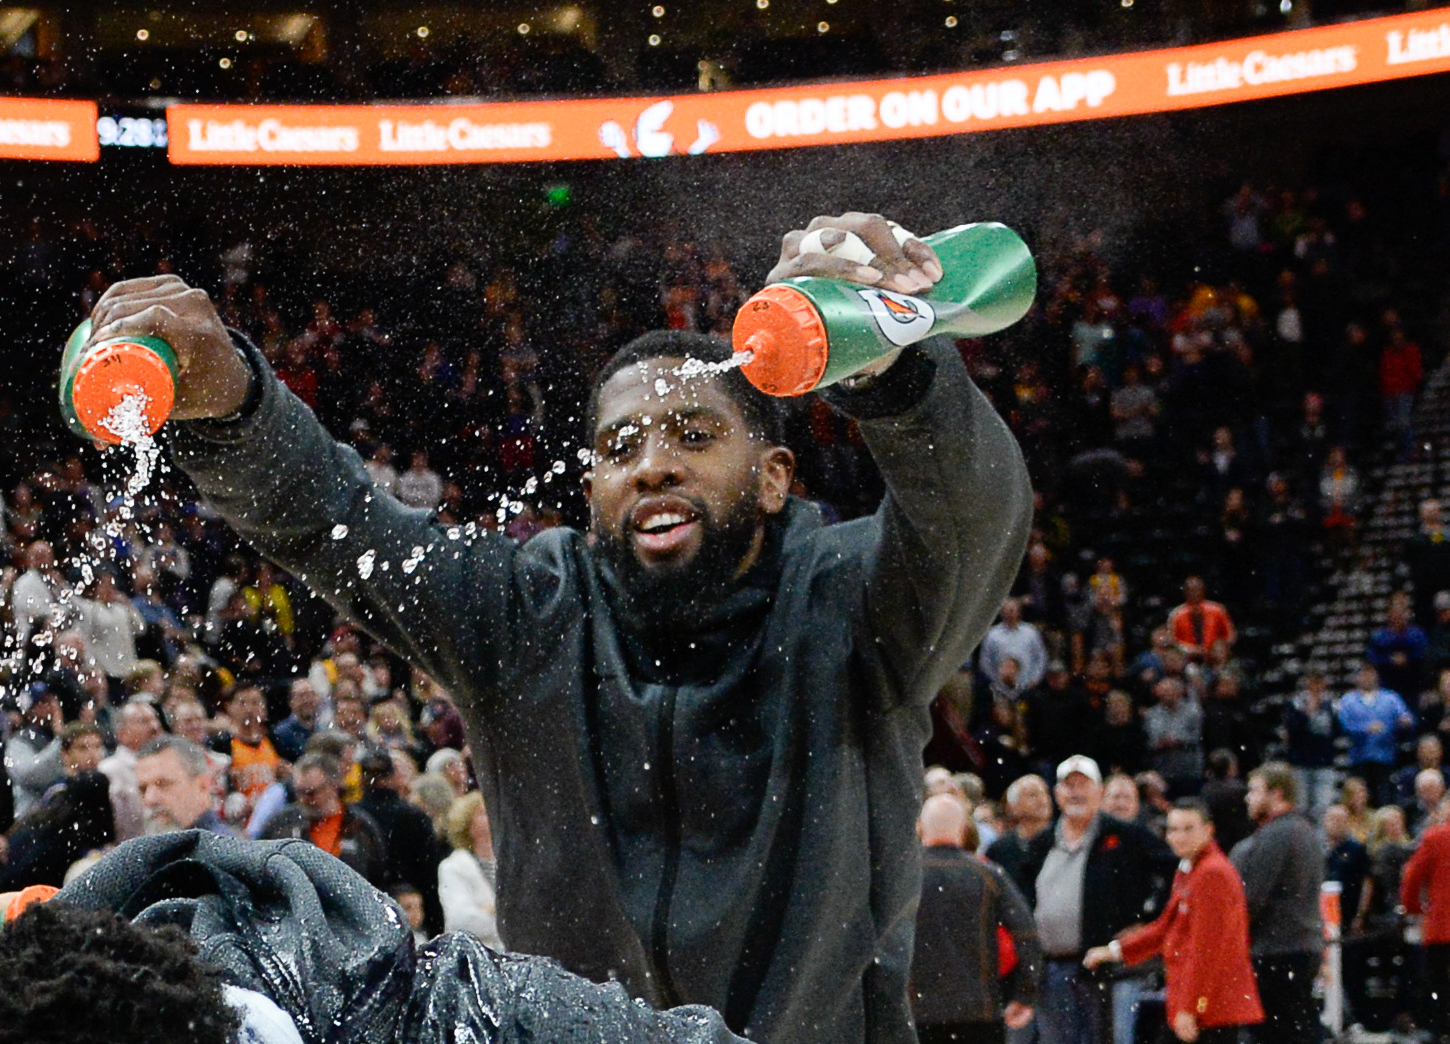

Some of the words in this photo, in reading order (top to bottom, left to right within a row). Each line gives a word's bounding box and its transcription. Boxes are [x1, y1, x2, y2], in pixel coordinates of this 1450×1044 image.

[1386, 24, 1450, 65] Littl
[745, 94, 877, 138] ORDER
[879, 89, 938, 128] ON
[941, 79, 1029, 122] OUR
[1032, 70, 1116, 107] APP
